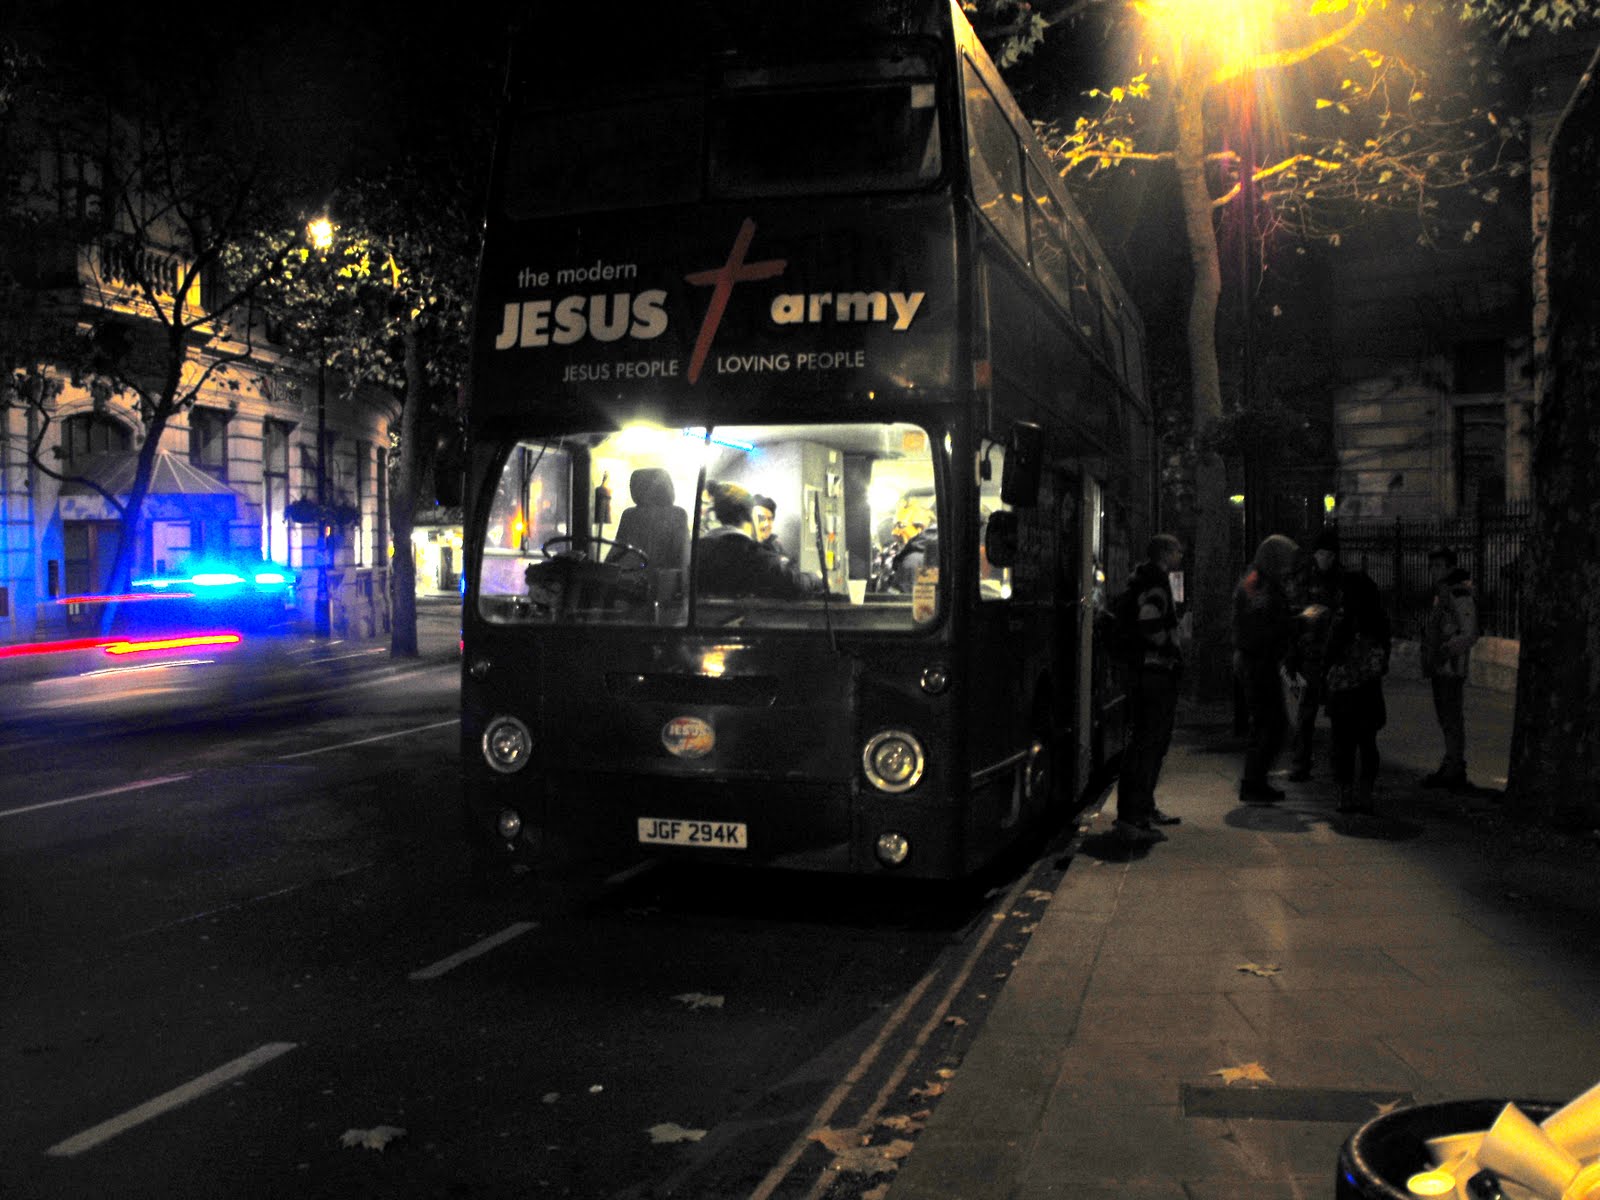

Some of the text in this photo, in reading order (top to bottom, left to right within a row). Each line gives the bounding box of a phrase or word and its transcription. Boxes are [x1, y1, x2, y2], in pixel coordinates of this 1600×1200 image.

[517, 259, 638, 288] the modern
[495, 288, 926, 350] JESUS army
[562, 351, 865, 383] JESUS PEOPLE LOVING PEOPLE
[647, 820, 739, 844] JGF 294K
